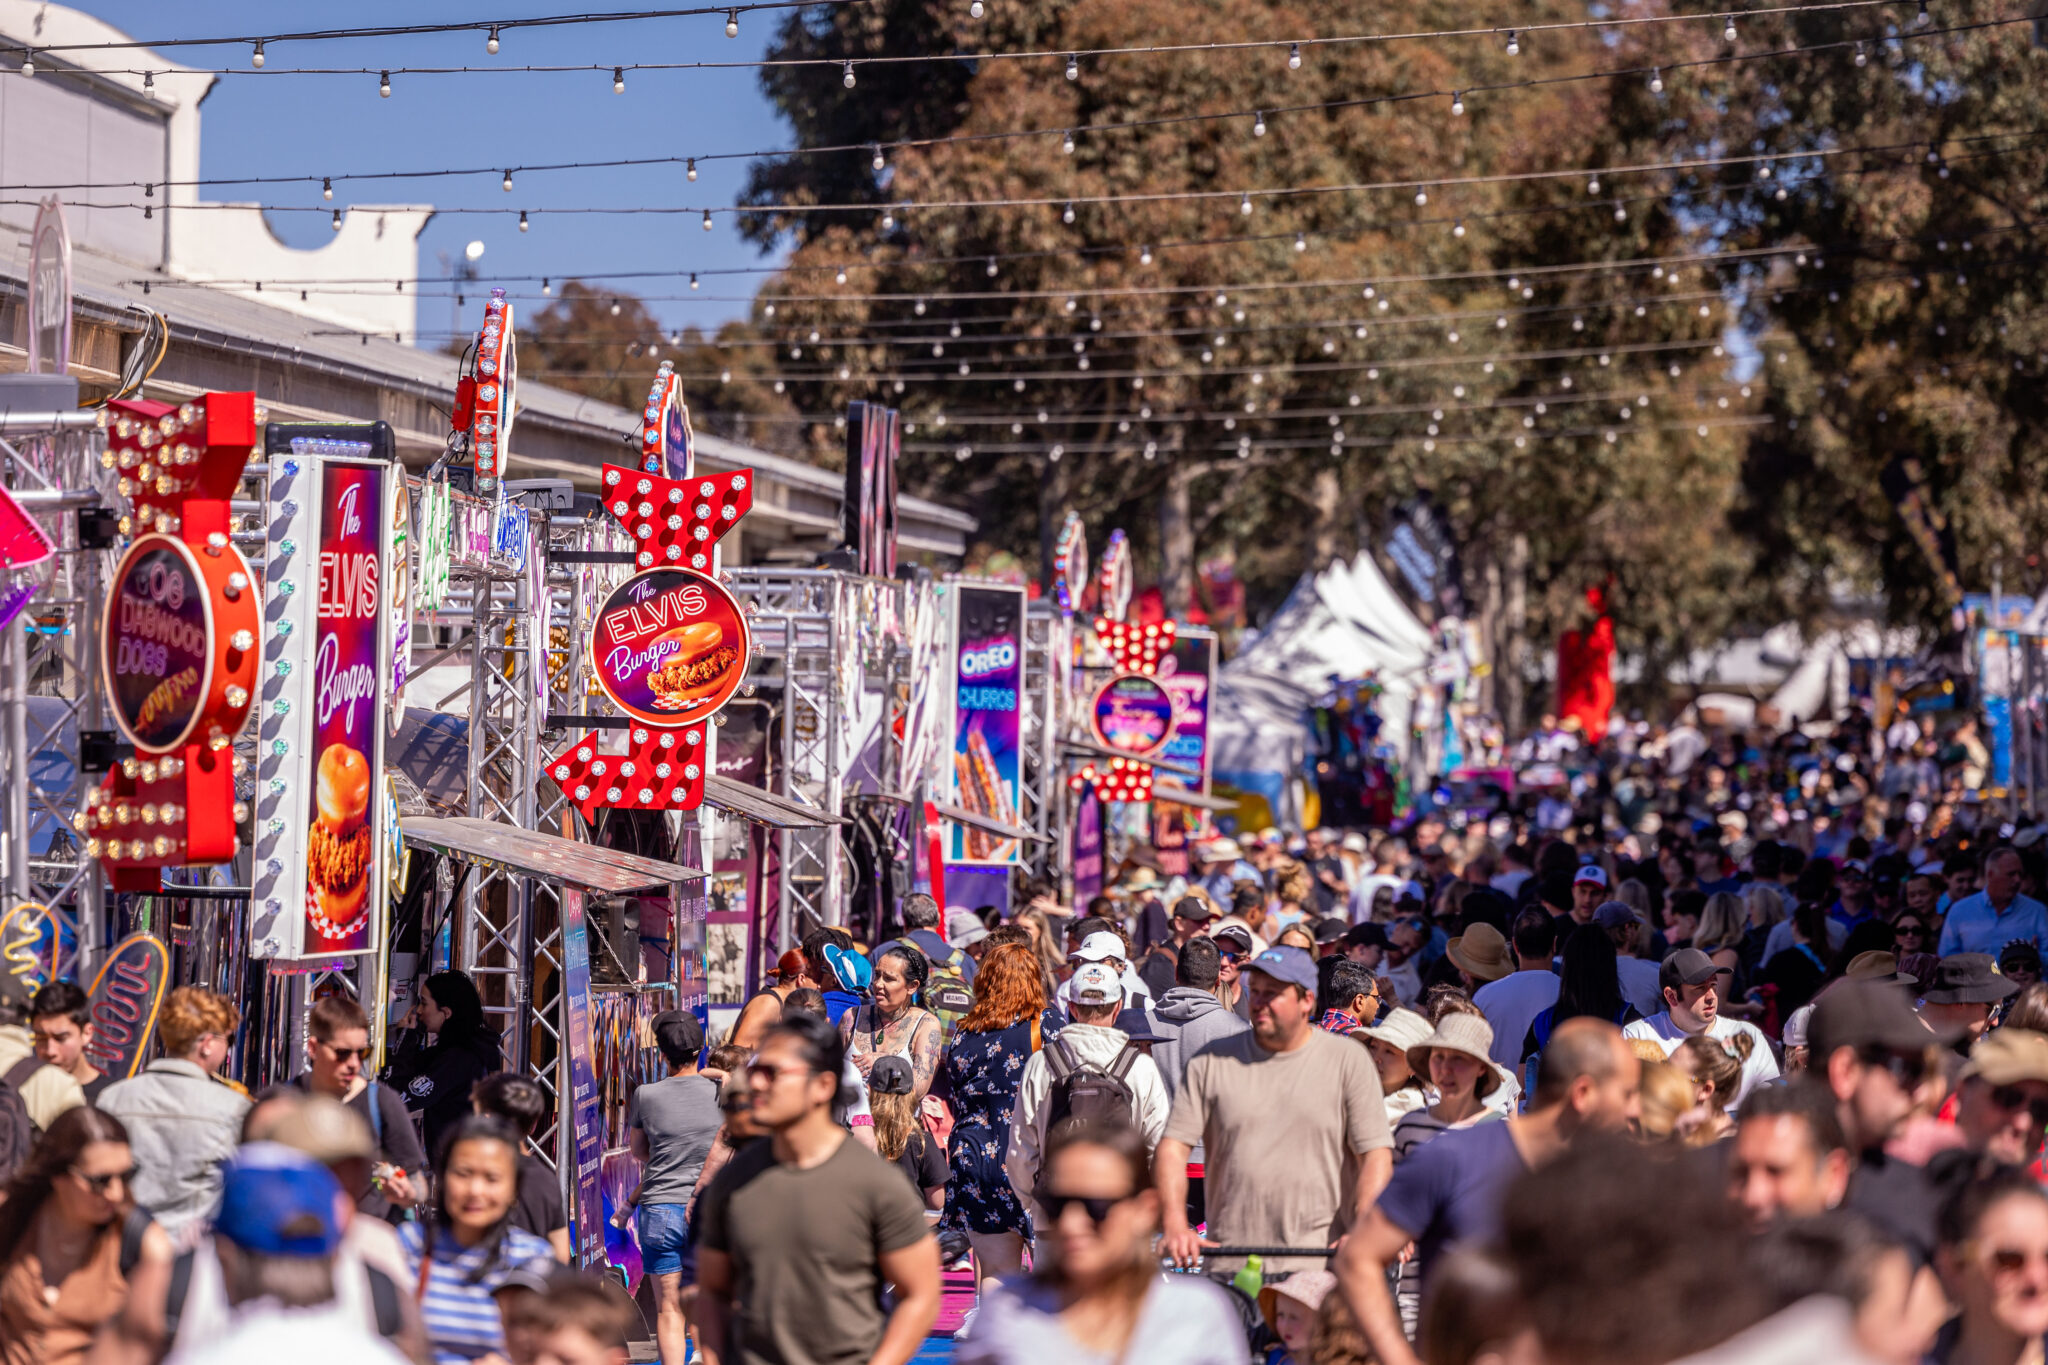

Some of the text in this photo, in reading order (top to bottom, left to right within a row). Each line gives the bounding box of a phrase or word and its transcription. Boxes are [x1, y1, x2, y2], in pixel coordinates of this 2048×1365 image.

[338, 483, 361, 541] The
[149, 562, 185, 610] OG
[317, 552, 379, 618] ELVIS
[628, 578, 656, 604] The
[120, 593, 206, 658] DAGWOOD
[605, 585, 707, 644] ELVIS
[116, 636, 169, 677] DOGS
[604, 640, 680, 682] Burger
[961, 644, 1016, 675] OREO
[315, 632, 376, 735] Burger
[959, 686, 1016, 712] CHURROS
